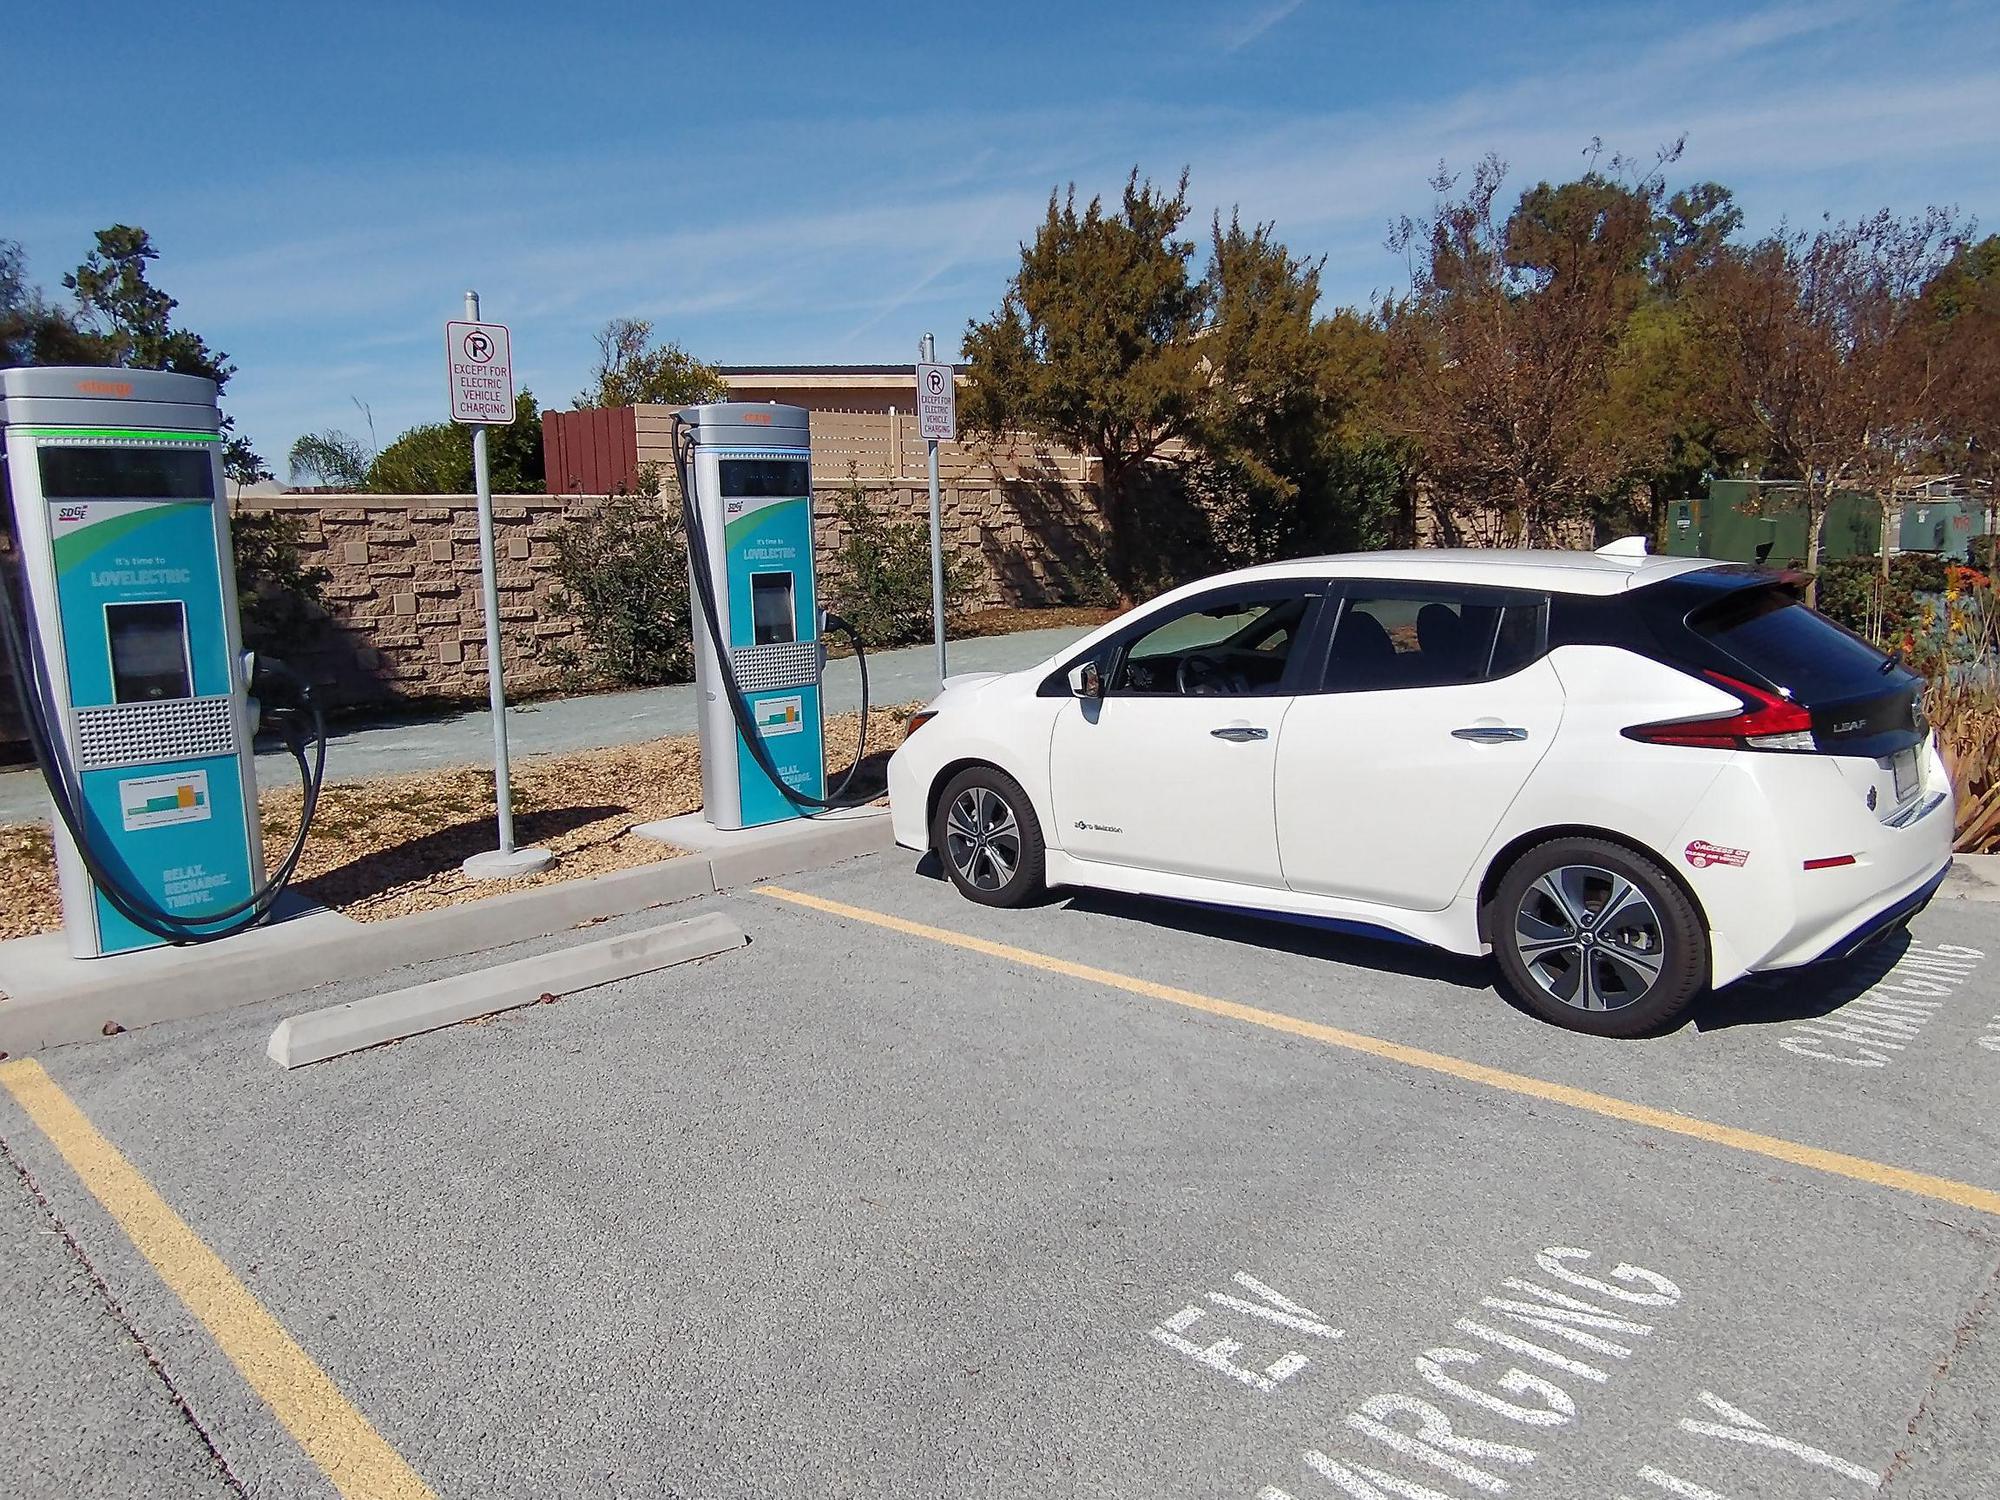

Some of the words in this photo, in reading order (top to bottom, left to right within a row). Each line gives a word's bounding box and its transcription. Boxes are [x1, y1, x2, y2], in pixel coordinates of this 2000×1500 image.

[454, 364, 487, 376] EXCEPT
[490, 366, 507, 377] FOR
[461, 377, 502, 389] ELECTRIC
[463, 390, 501, 401] VEHICLE
[460, 402, 506, 414] CHARGING
[925, 405, 949, 414] ELECTRIC
[926, 415, 948, 424] VEHICLE
[924, 425, 951, 433] CHARGING
[132, 557, 153, 566] time
[156, 556, 166, 565] to
[91, 568, 191, 587] LOVELECTRIC
[1833, 719, 1867, 733] LEAF
[1150, 1269, 1347, 1393] EV
